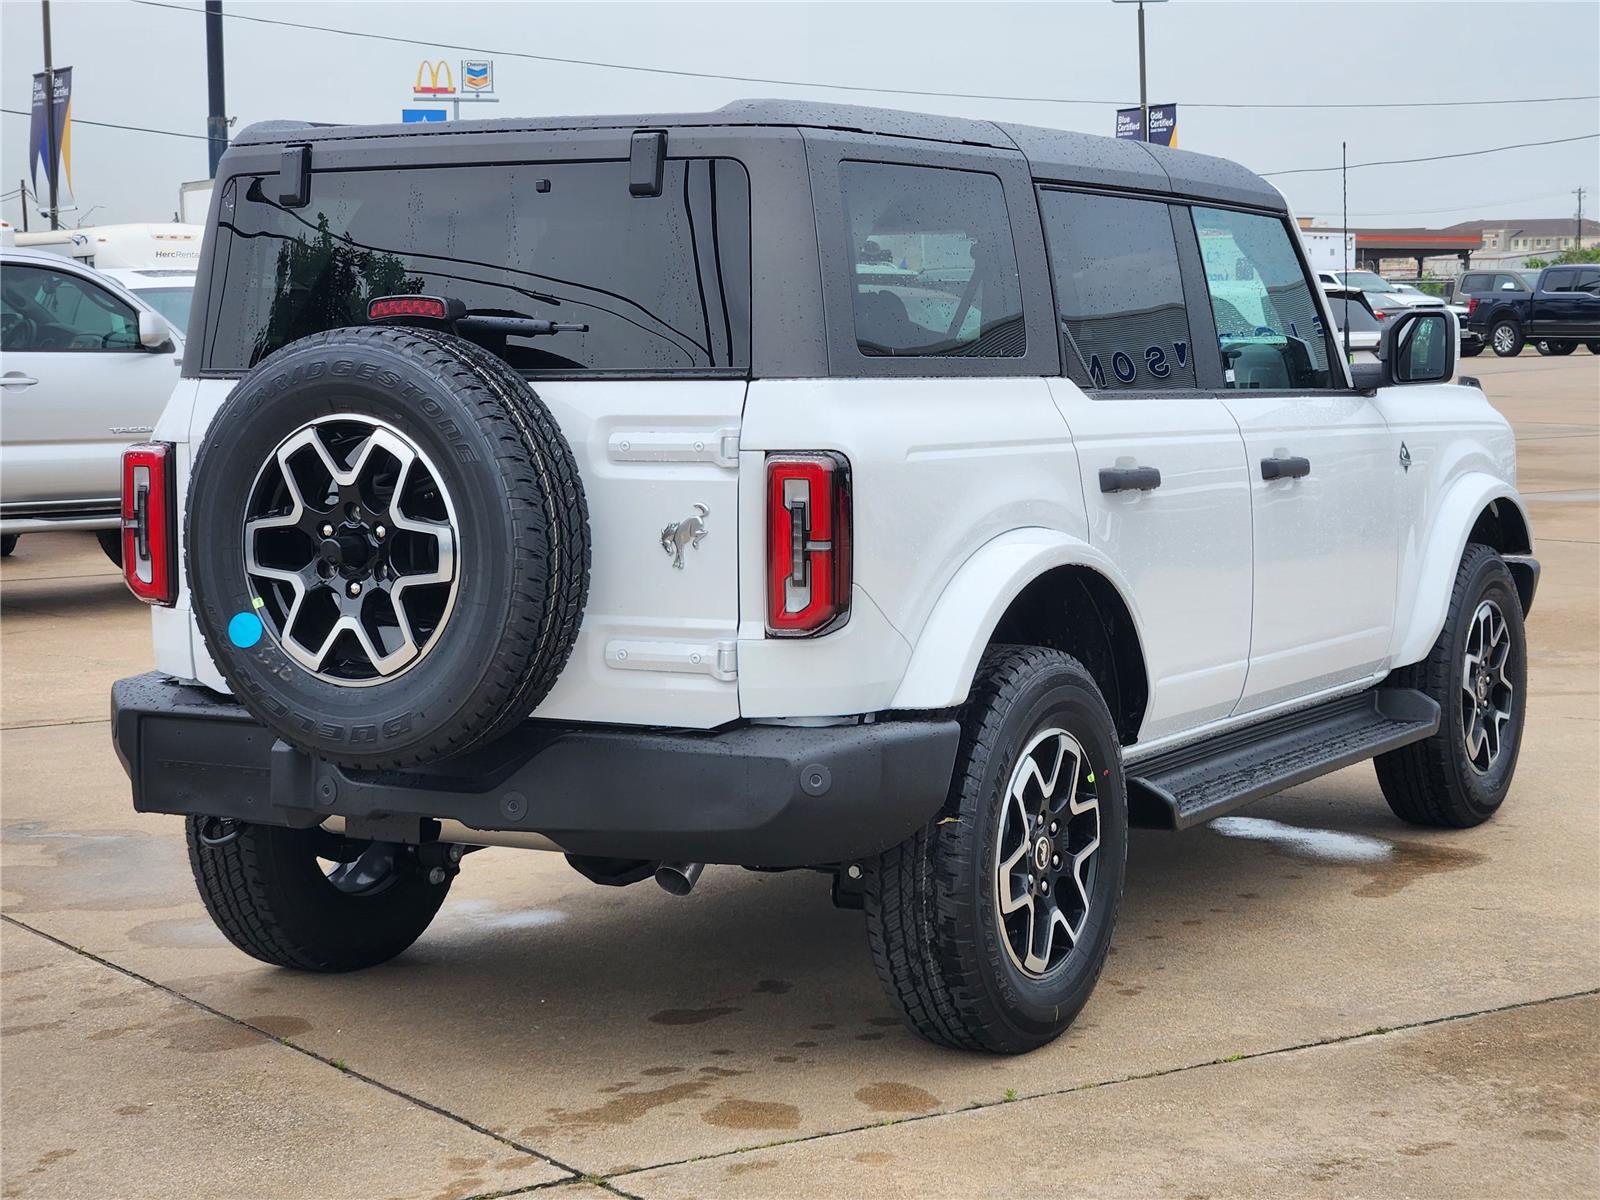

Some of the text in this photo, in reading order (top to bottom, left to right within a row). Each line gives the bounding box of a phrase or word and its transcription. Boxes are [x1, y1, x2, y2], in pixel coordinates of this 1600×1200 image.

[1150, 111, 1163, 119] Gold
[1118, 122, 1140, 131] Certified
[1150, 119, 1173, 128] Certified
[247, 359, 481, 465] BRIDGESTONE
